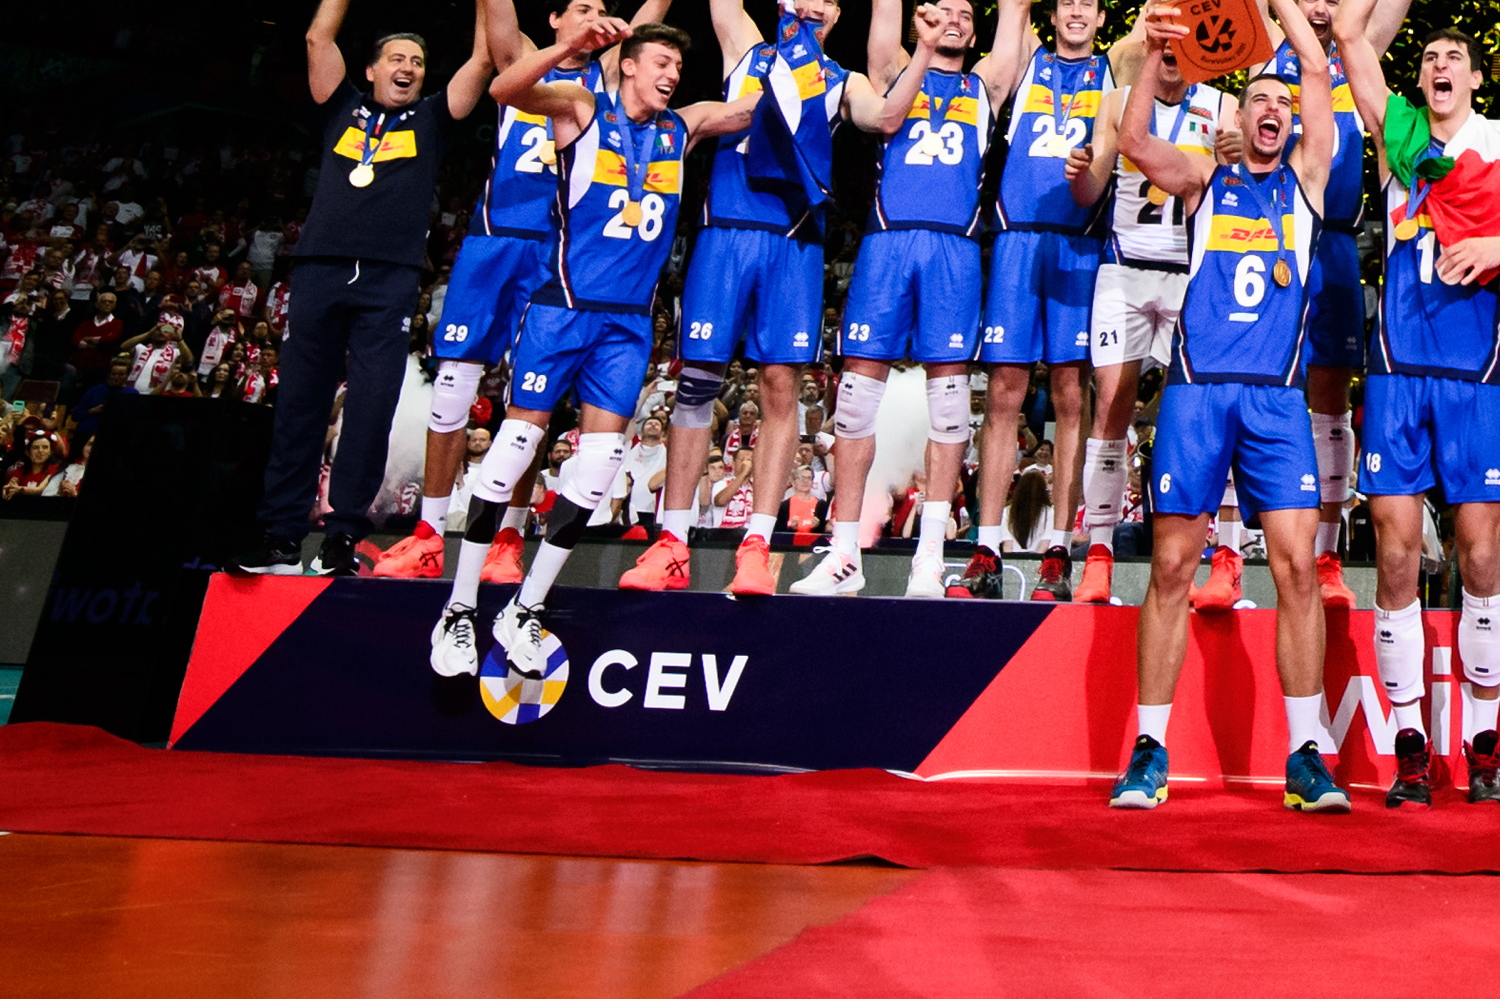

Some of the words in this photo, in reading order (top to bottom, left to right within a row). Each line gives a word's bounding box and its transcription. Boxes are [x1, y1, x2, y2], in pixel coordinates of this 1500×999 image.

[904, 119, 964, 166] 23
[1028, 114, 1087, 159] 22
[515, 127, 558, 175] 2
[1137, 180, 1184, 226] 21
[602, 188, 666, 242] 28
[1233, 254, 1267, 308] 6
[444, 323, 469, 343] 29
[689, 321, 714, 341] 26
[848, 322, 871, 342] 23
[984, 325, 1005, 344] 22
[1099, 329, 1119, 347] 21
[521, 371, 548, 393] 28
[1366, 452, 1381, 473] 18
[1159, 472, 1171, 494] 6
[588, 650, 748, 713] CEV
